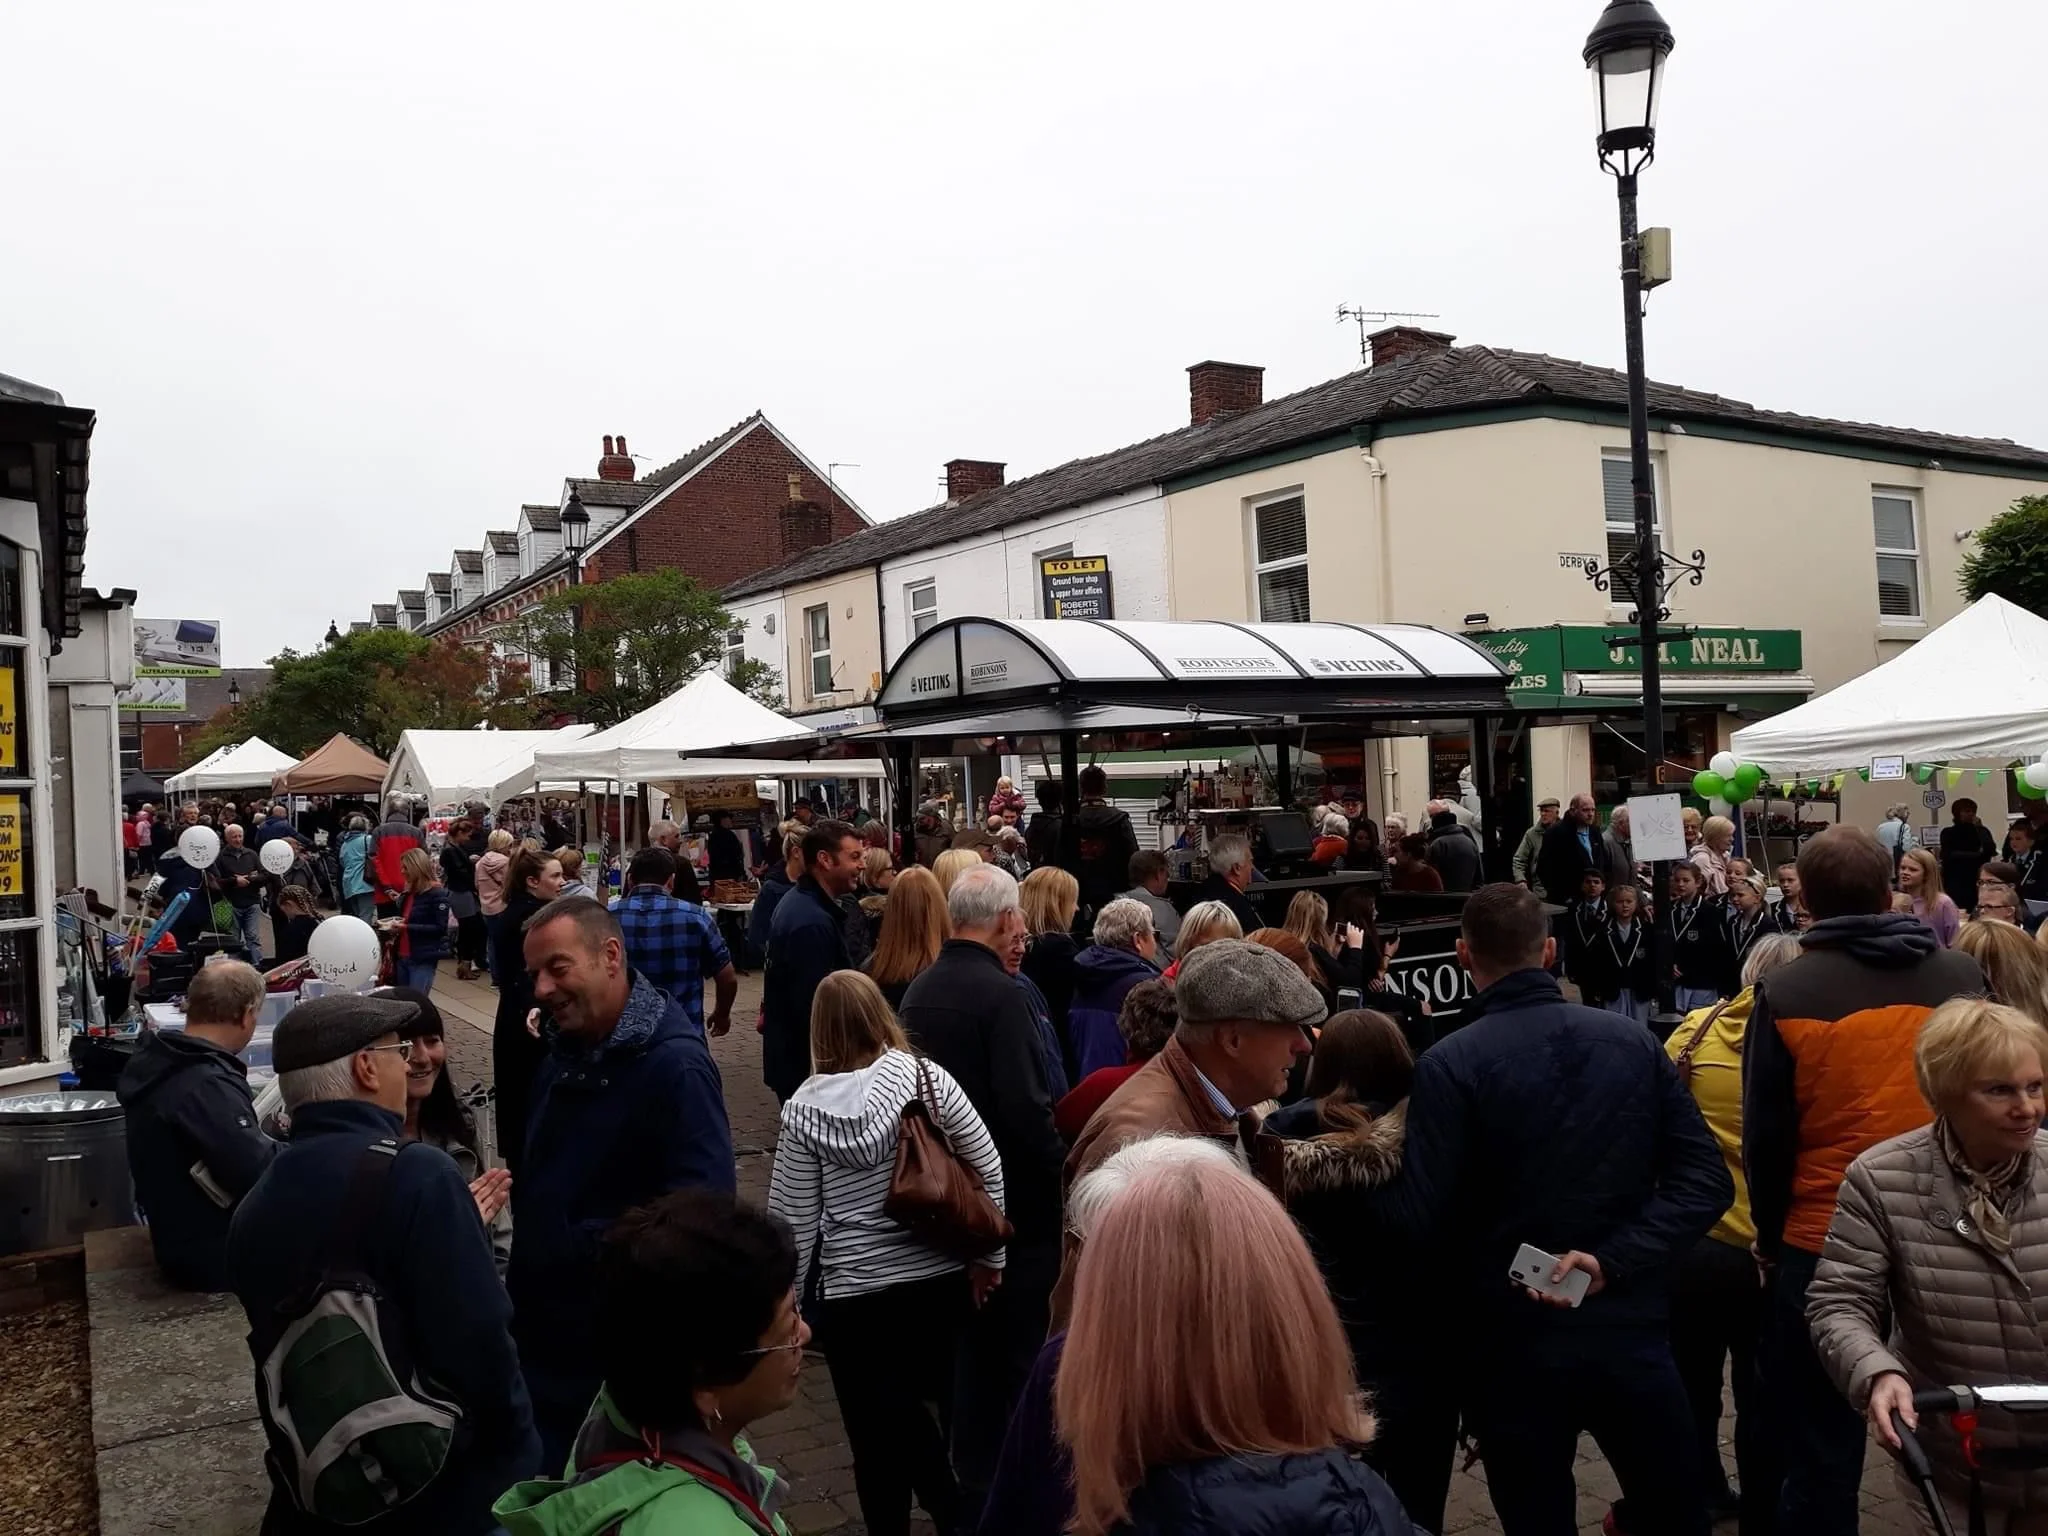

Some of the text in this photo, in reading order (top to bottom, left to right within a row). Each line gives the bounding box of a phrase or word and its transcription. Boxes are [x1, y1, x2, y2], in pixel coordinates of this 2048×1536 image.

[1051, 560, 1096, 570] TO LET
[1560, 556, 1587, 568] DERBY
[1052, 577, 1071, 586] Ground
[1085, 575, 1098, 584] shop
[1056, 590, 1071, 599] upper
[1085, 586, 1103, 595] offices
[1061, 600, 1098, 609] ROBERTS
[1062, 608, 1099, 617] ROBERTS
[1690, 637, 1765, 665] NEAL
[1177, 659, 1276, 668] ROBINSONS
[1325, 660, 1404, 671] VELTINS
[1507, 660, 1523, 672] &
[970, 663, 1008, 678] ROBINSONS
[918, 674, 950, 692] VELTINS
[324, 962, 357, 976] Liquid
